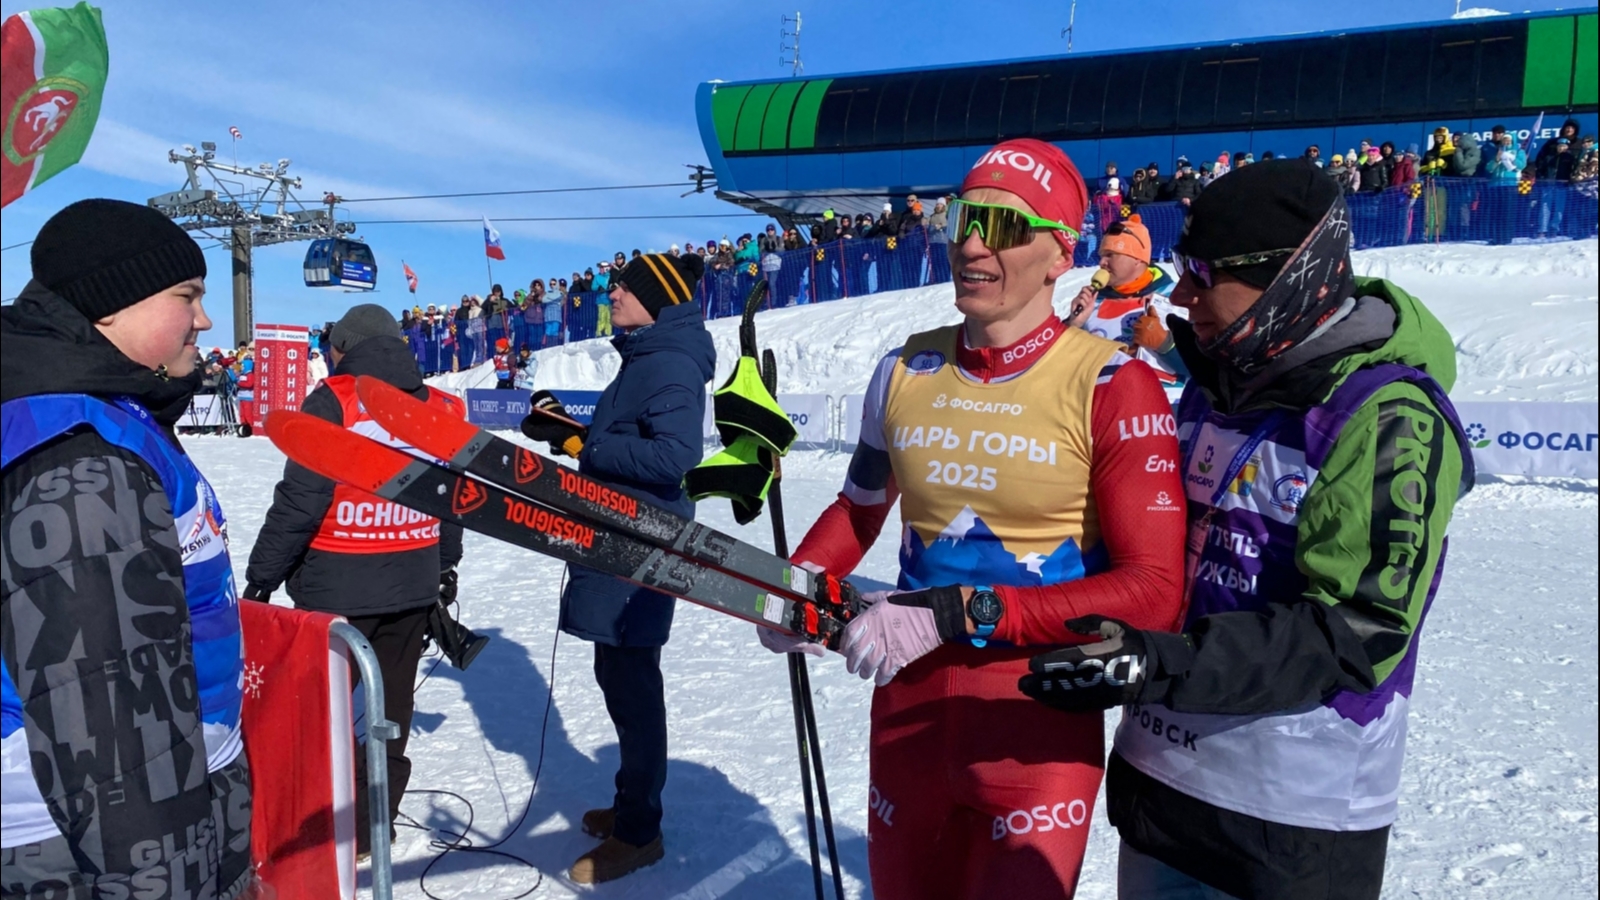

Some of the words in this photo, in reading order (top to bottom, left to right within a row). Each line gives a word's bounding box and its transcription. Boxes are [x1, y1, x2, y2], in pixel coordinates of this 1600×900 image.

[972, 150, 1052, 193] UKOIL
[1002, 327, 1055, 365] BOSCO
[949, 397, 1023, 416] ФОСАГРО
[893, 426, 961, 451] ЦАРЬ
[967, 430, 1057, 465] ГОРЫ
[1118, 413, 1178, 441] LUKO
[556, 467, 637, 519] ROSSIGNOL
[925, 460, 998, 491] 2025
[504, 496, 595, 549] ROSSIGNOL
[869, 785, 895, 827] OIL
[991, 799, 1087, 841] BOSCO
